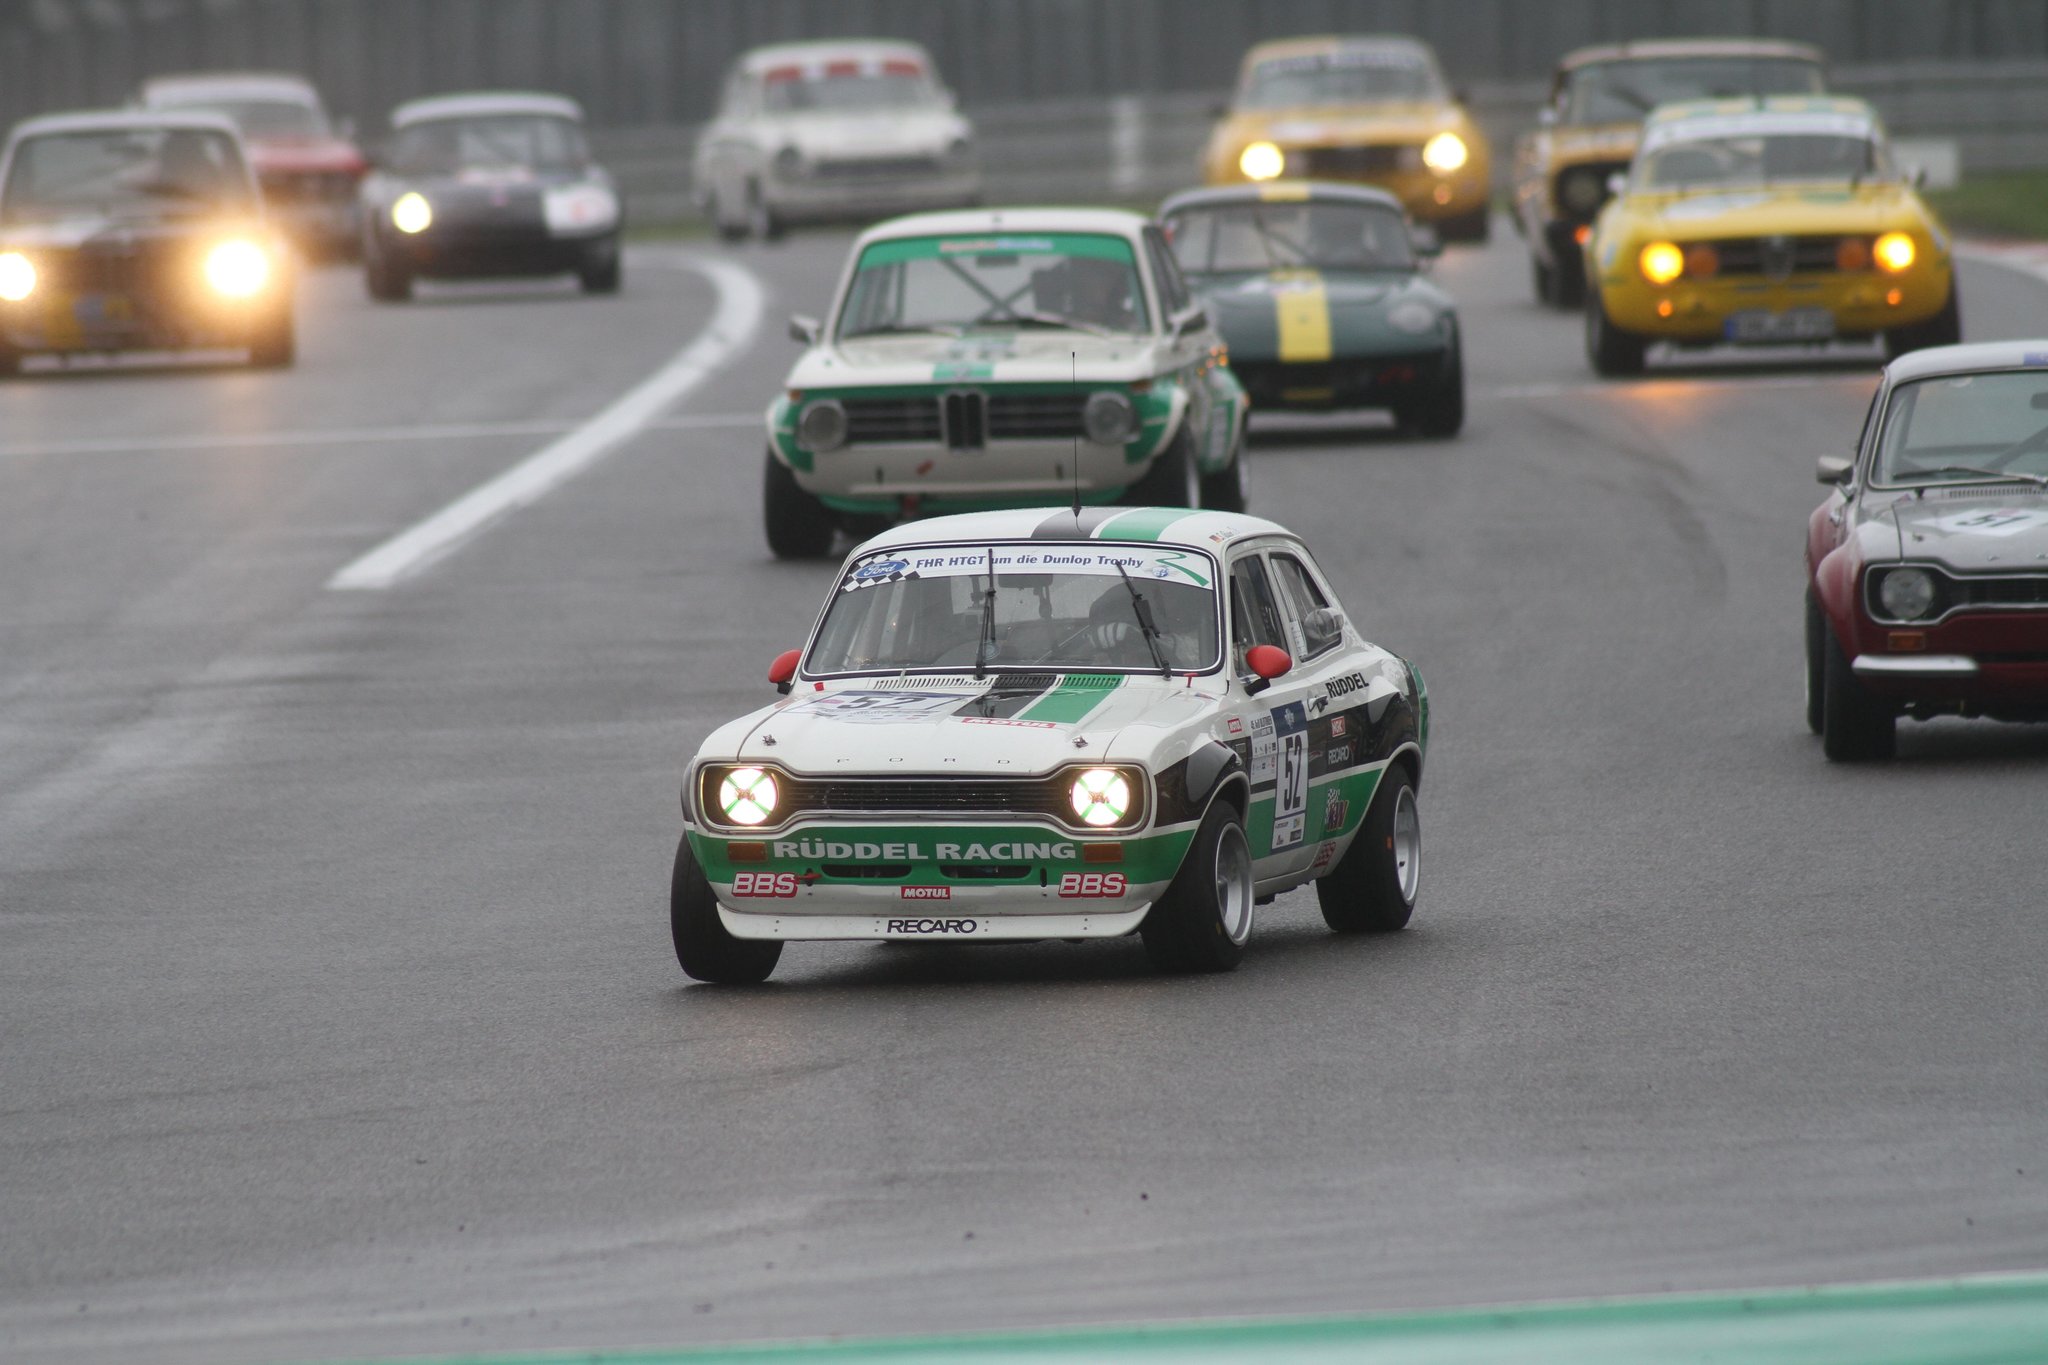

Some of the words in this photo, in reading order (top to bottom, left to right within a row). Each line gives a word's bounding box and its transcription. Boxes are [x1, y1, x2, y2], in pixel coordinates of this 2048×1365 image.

[916, 557, 945, 568] FHR
[948, 555, 987, 566] HTGT
[991, 556, 1012, 564] um
[1016, 554, 1039, 564] die
[1043, 555, 1093, 566] Dunlop
[1097, 556, 1145, 568] Trophy
[864, 564, 895, 577] Ford
[1325, 672, 1370, 698] RÜDDEL
[837, 696, 927, 709] 52
[965, 719, 1052, 727] MOTUL
[1328, 745, 1350, 765] RECARO
[1284, 735, 1302, 811] 52
[773, 838, 929, 860] RÜDDEL
[935, 842, 1076, 860] RACING
[733, 873, 797, 894] BBS
[1060, 873, 1124, 895] BBS
[904, 888, 948, 898] MOTUL
[887, 919, 977, 933] RECARO
